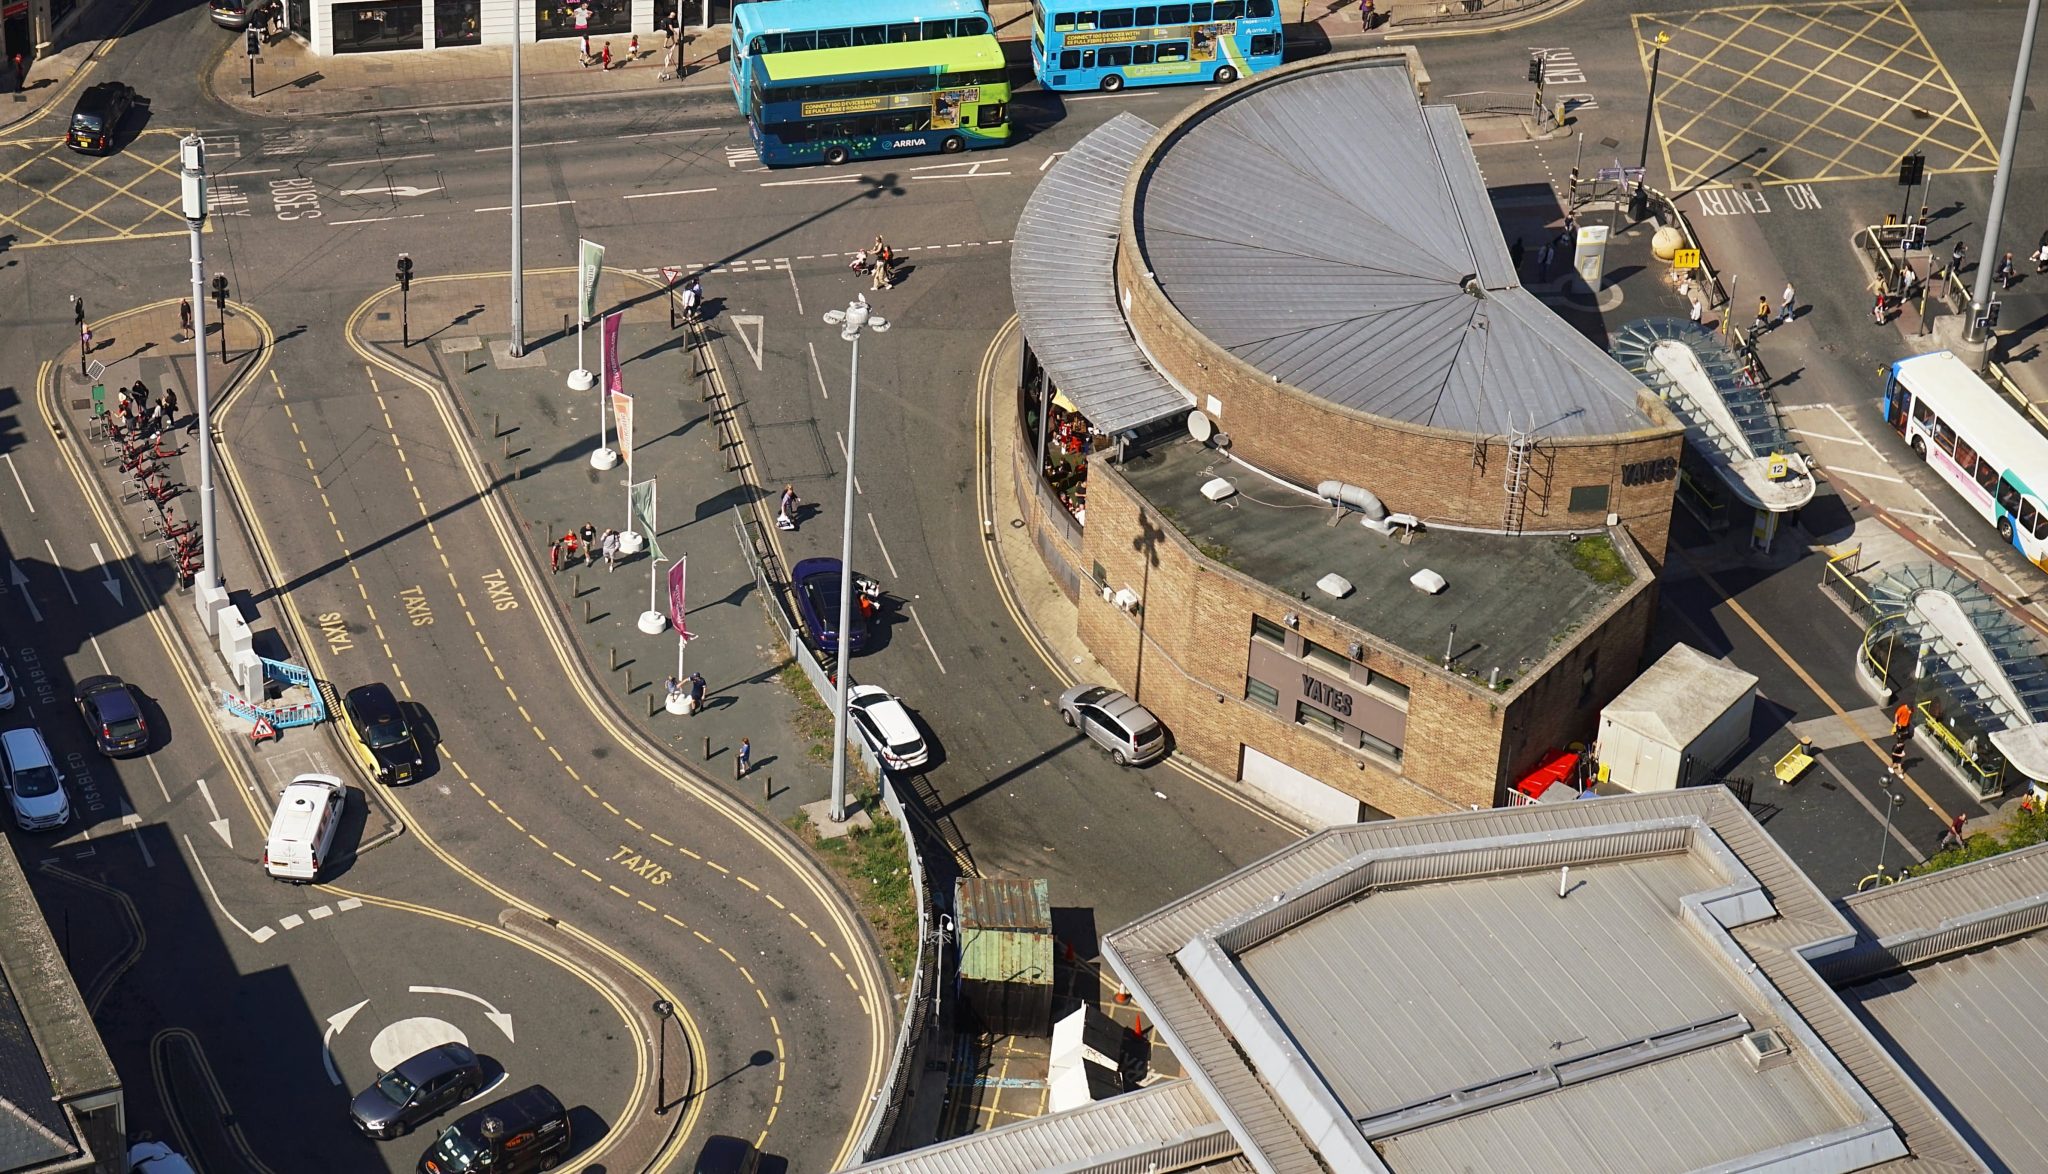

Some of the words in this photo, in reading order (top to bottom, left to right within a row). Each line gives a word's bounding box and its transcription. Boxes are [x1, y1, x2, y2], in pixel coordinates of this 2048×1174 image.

[893, 138, 926, 148] ARRIVA
[269, 177, 322, 220] BUSES
[1695, 189, 1771, 216] ENTRY
[1783, 183, 1822, 210] NO
[1621, 456, 1677, 487] YATES
[1772, 465, 1783, 474] 12
[400, 584, 434, 627] TAXIS
[481, 568, 519, 611] TAXIS
[318, 611, 354, 656] TAXIS
[20, 647, 56, 705] DISABLED
[1302, 673, 1353, 717] YATES
[67, 752, 105, 811] DISABLED
[612, 845, 672, 885] TAXIS
